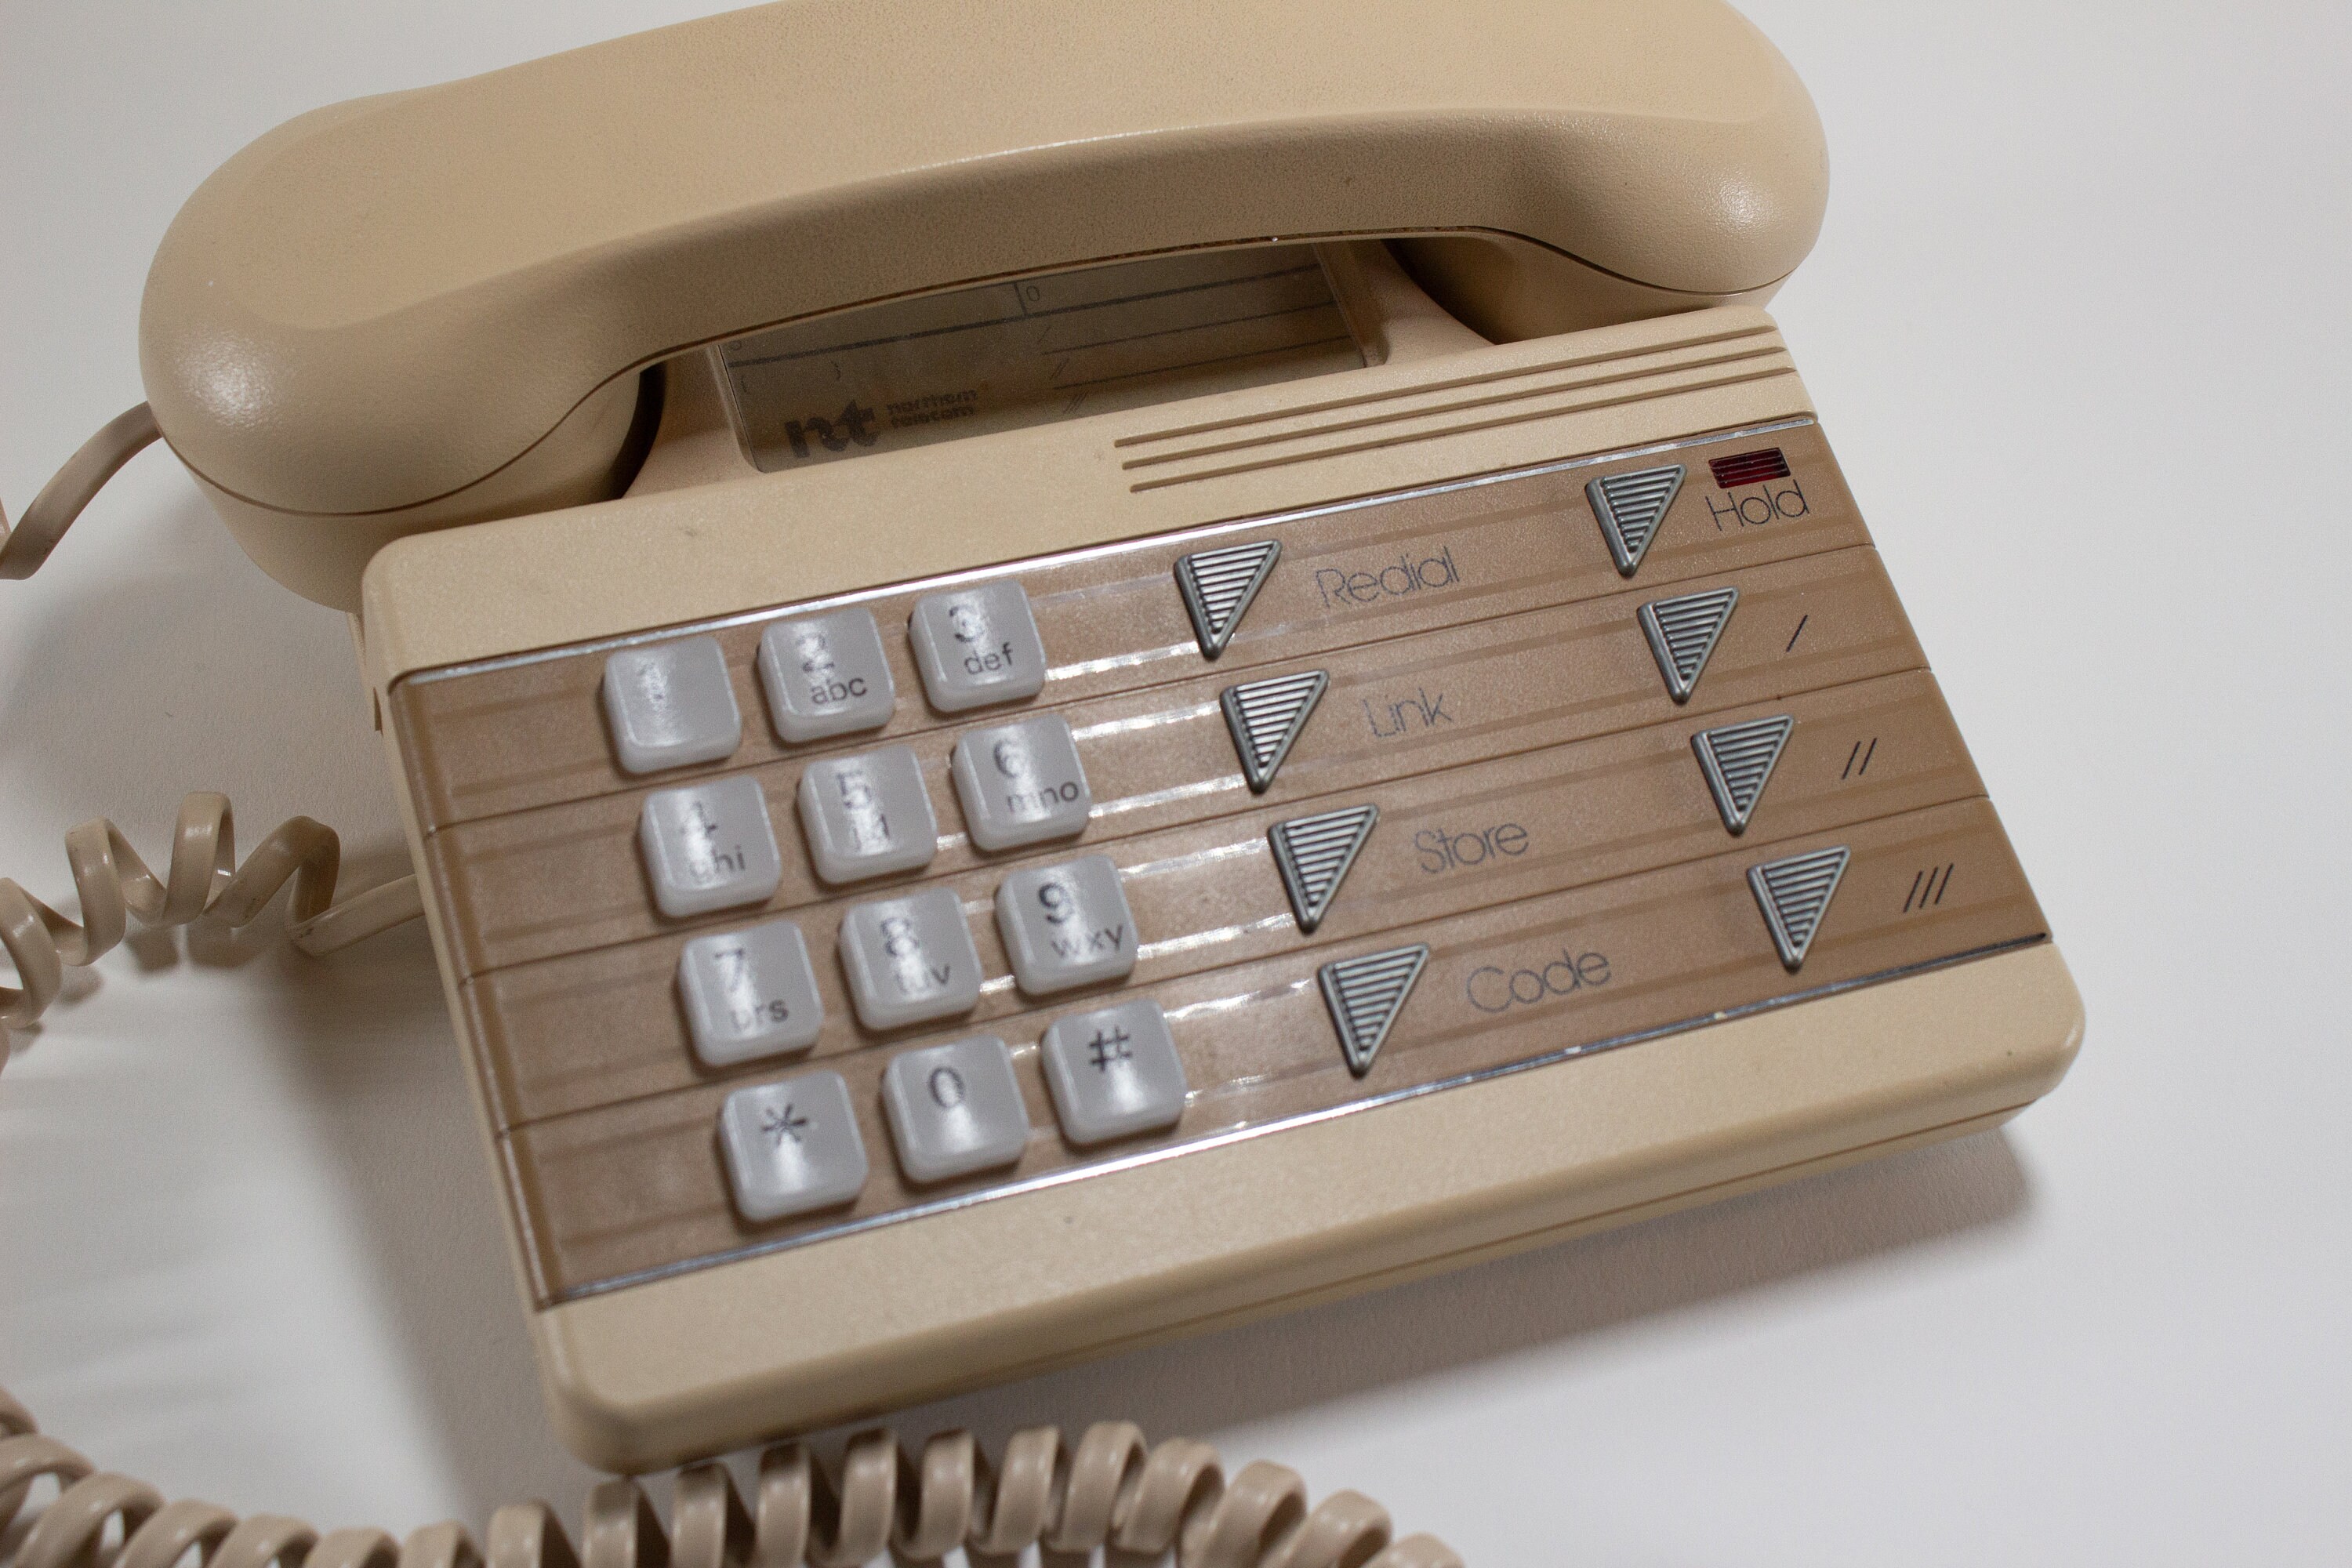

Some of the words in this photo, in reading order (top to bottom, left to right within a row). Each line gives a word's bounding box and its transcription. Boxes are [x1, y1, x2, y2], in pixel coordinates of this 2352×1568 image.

[1704, 479, 1809, 532] Hold
[1315, 546, 1461, 609] Redial
[948, 604, 987, 643] 3
[964, 642, 1014, 675] def
[811, 676, 868, 706] abc
[1363, 688, 1454, 739] Link
[1414, 822, 1530, 874] Store
[1037, 881, 1075, 924] 9
[1466, 949, 1612, 1014] Code
